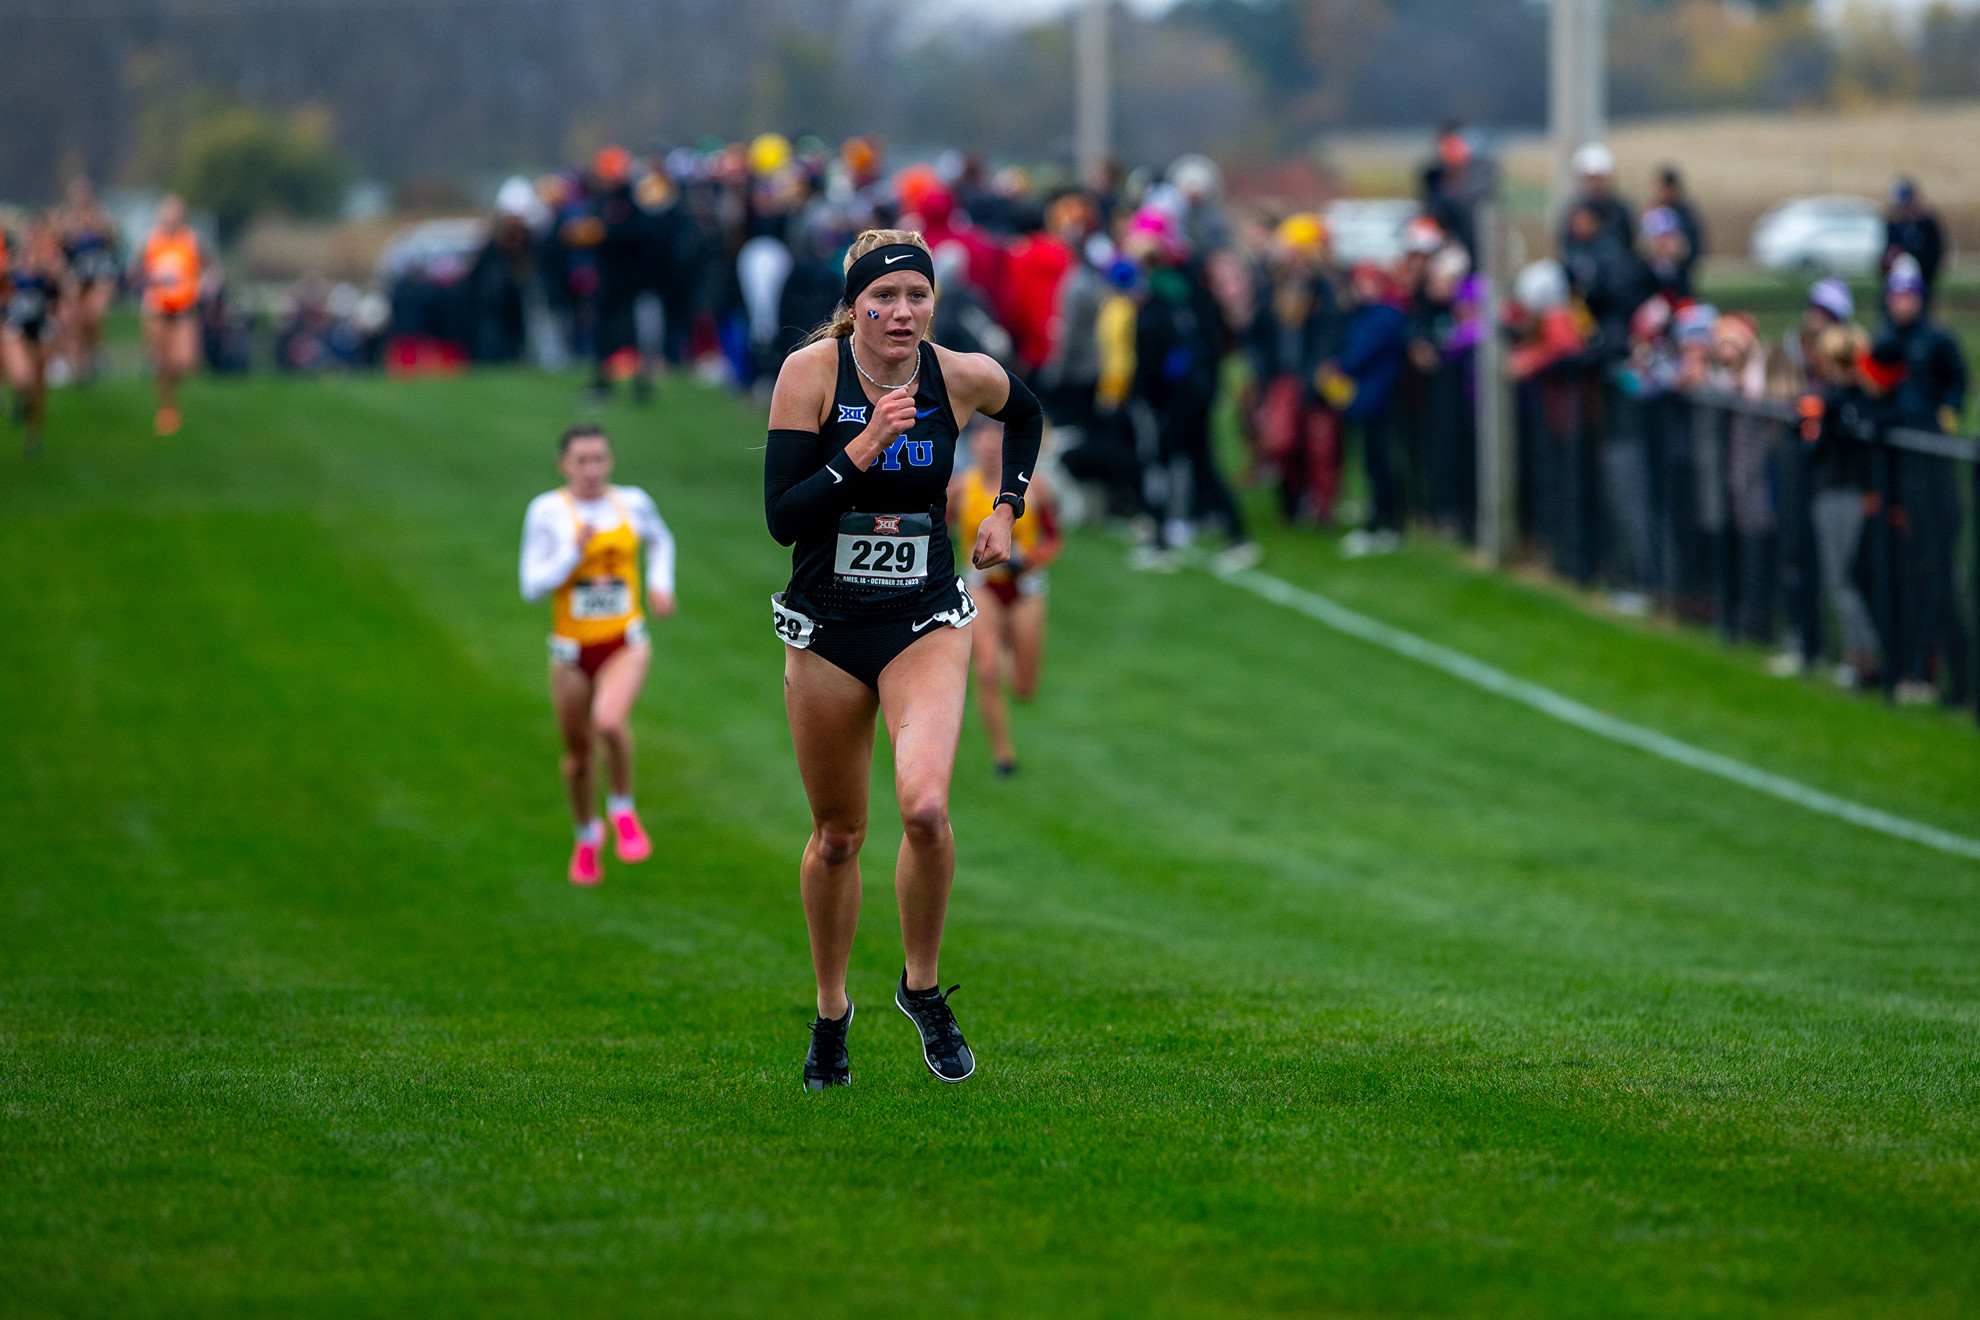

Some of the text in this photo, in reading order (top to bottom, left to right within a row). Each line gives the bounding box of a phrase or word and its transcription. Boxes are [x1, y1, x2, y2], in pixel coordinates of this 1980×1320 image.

[869, 434, 933, 470] YU
[849, 540, 916, 573] 229
[870, 577, 896, 585] OCTOBER
